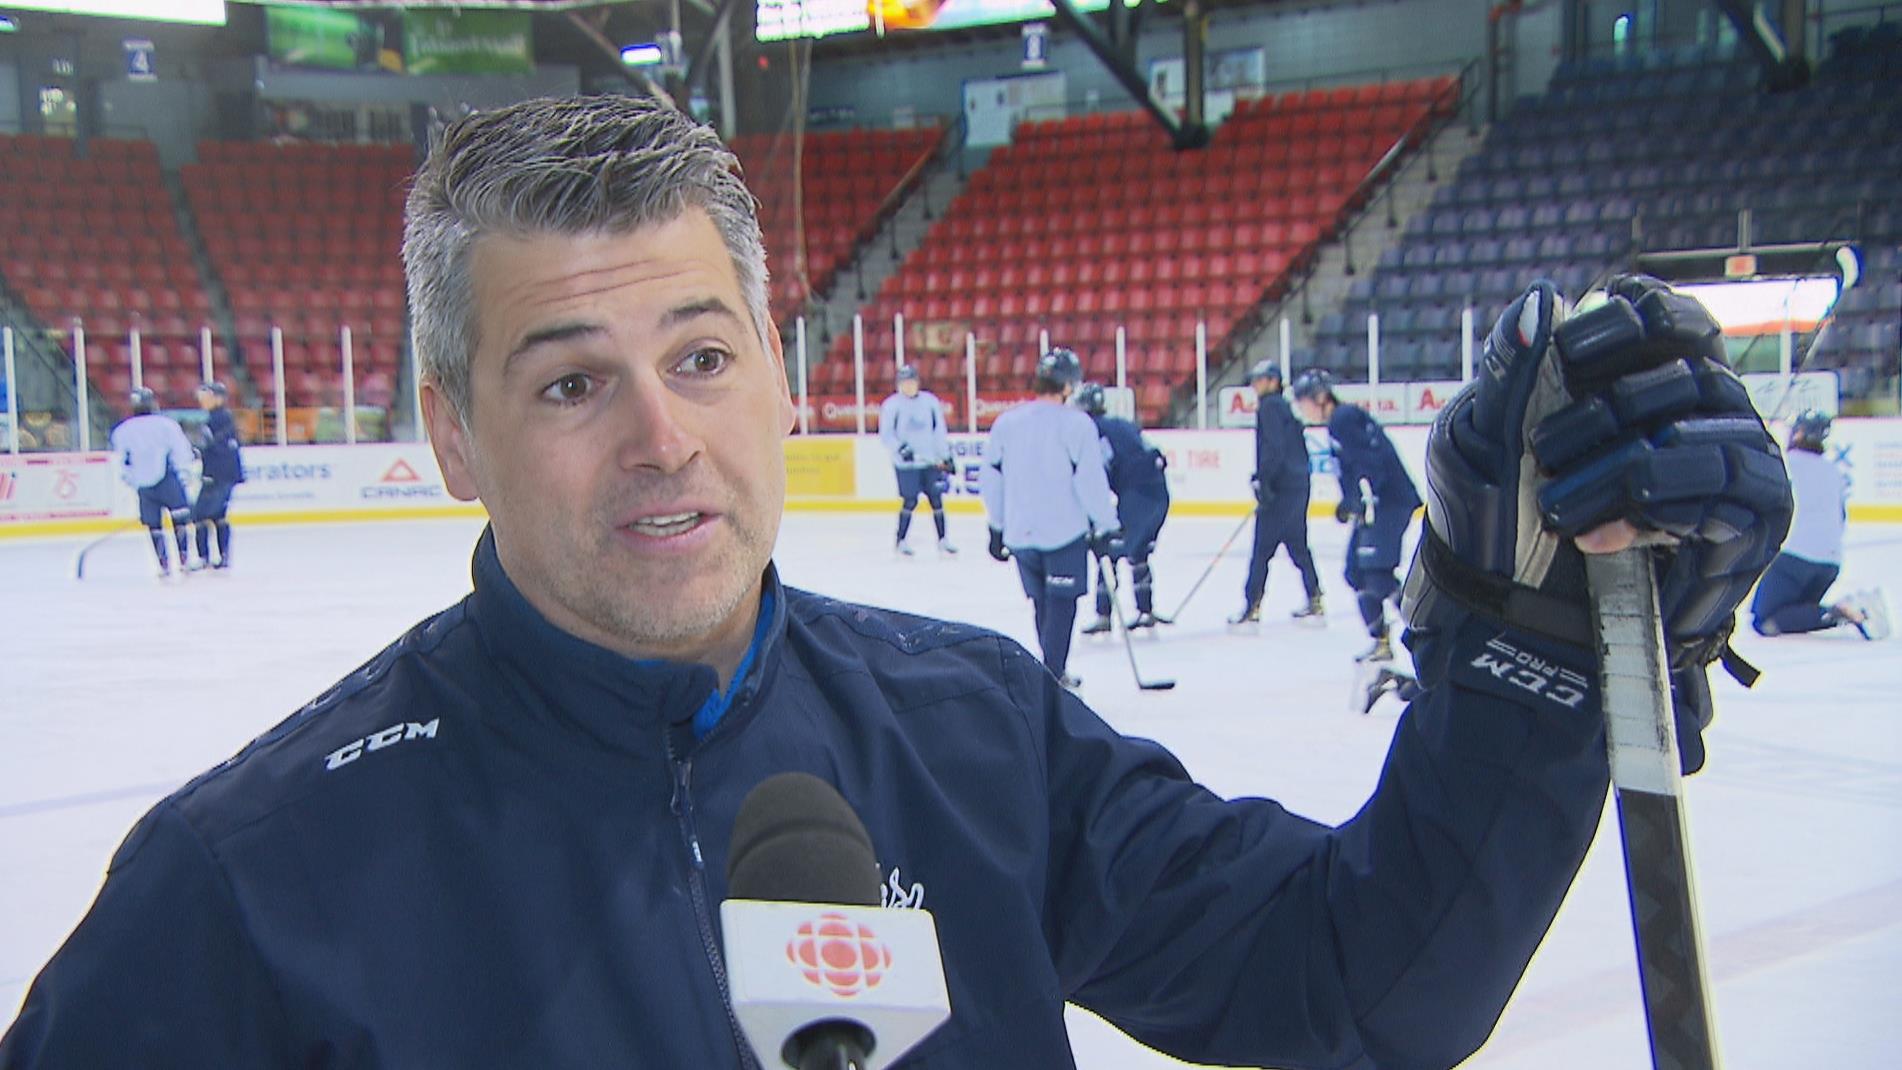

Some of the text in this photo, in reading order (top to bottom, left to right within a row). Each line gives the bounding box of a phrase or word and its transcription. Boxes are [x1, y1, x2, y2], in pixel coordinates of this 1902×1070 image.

[132, 50, 149, 73] 4
[1470, 653, 1584, 707] CCM
[1515, 652, 1558, 677] PRO
[324, 717, 440, 771] CCM
